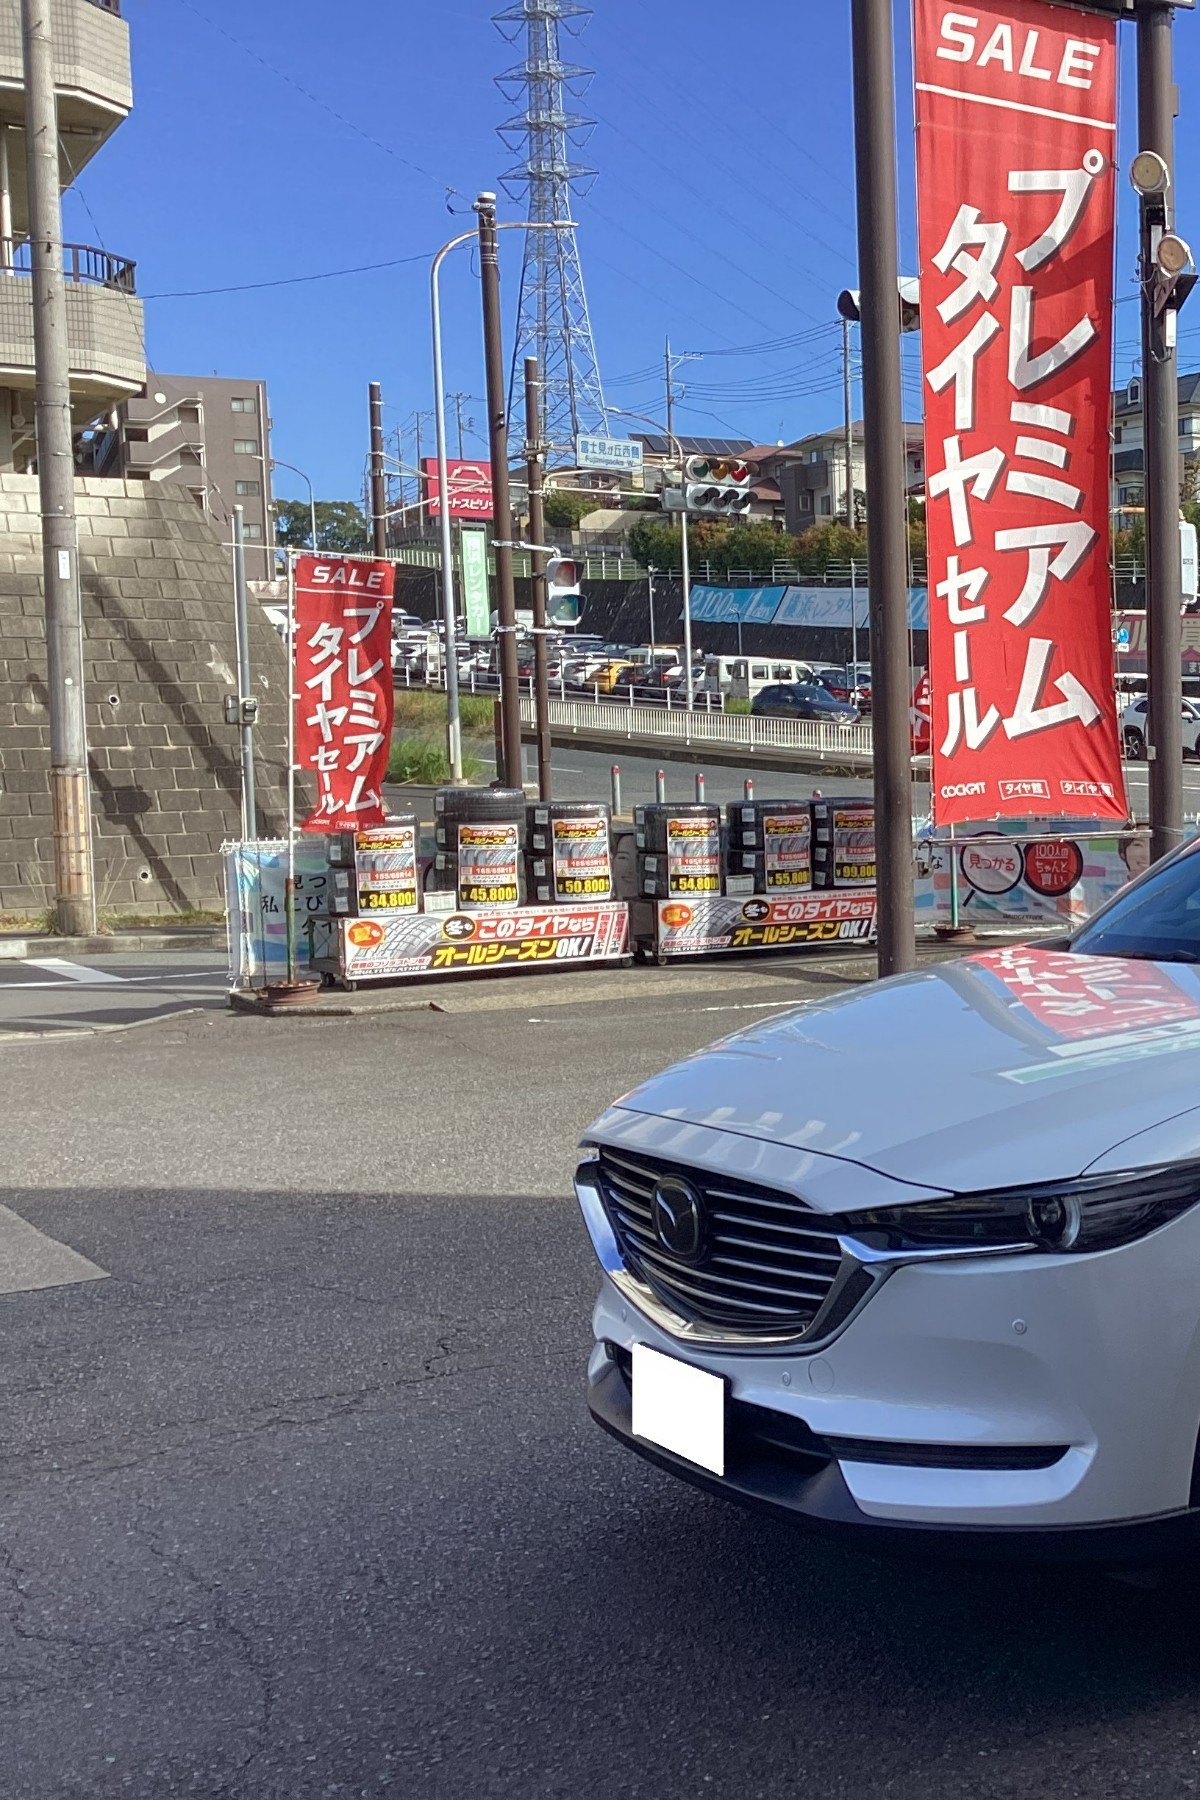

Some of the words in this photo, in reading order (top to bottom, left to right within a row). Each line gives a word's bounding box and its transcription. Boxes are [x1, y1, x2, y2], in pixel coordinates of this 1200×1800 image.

[936, 12, 1100, 89] SALE
[995, 149, 1104, 740] プレミアム
[925, 203, 1008, 758] タイヤセール
[312, 566, 385, 588] SALE
[343, 601, 385, 813] プレミアム
[305, 622, 349, 817] タイヤセール
[941, 781, 985, 798] COCKPIT
[1005, 783, 1043, 795] タイヤ館
[1036, 844, 1068, 857] 100人の
[969, 853, 1016, 872] 見つかる
[1035, 859, 1068, 873] ちゃんと
[744, 903, 768, 918] 冬も
[773, 901, 873, 920] このタイヤなら
[445, 920, 473, 936] 冬も
[479, 916, 595, 938] このタイヤなら
[732, 919, 870, 946] オールシーズンOK!
[433, 936, 592, 967] オールシーズンOK!
